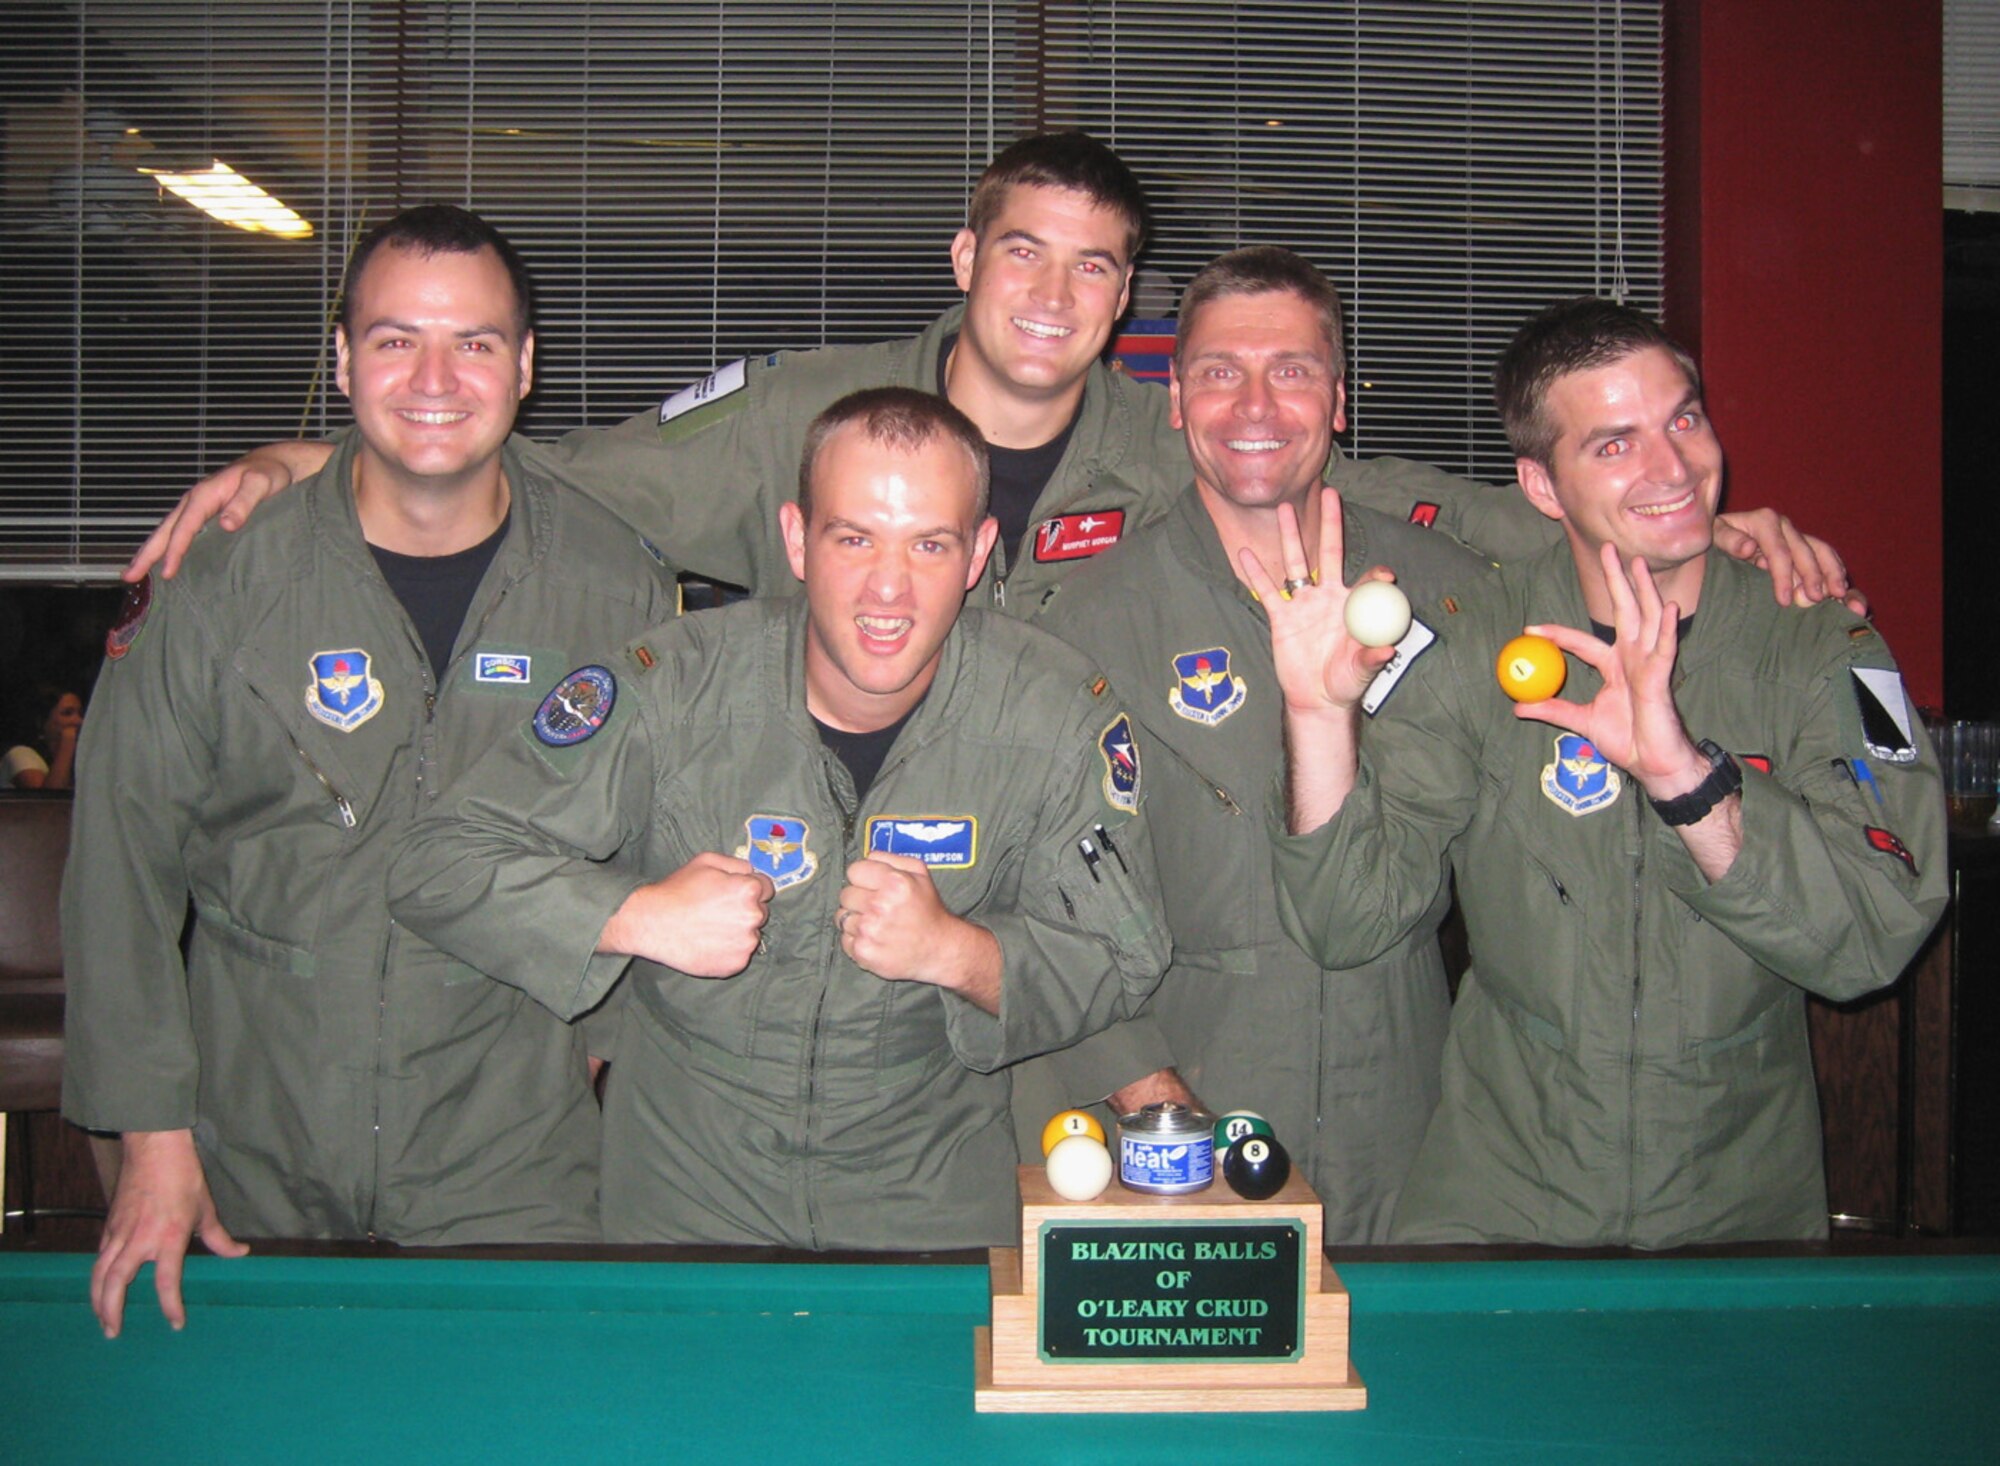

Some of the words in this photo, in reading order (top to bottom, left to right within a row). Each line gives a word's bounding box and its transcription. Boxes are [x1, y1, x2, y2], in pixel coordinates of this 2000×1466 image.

[924, 852, 964, 862] SIMPSON
[1072, 1118, 1079, 1130] 1
[1231, 1122, 1247, 1136] 14
[1123, 1140, 1170, 1169] Heat
[1251, 1143, 1260, 1157] 8
[1071, 1242, 1186, 1260] BLAZING
[1194, 1242, 1277, 1260] BALLS
[1156, 1271, 1192, 1289] OF
[1077, 1299, 1189, 1317] O'LEARY
[1195, 1299, 1269, 1317] CRUD
[1083, 1328, 1263, 1346] TOURNAMENT
